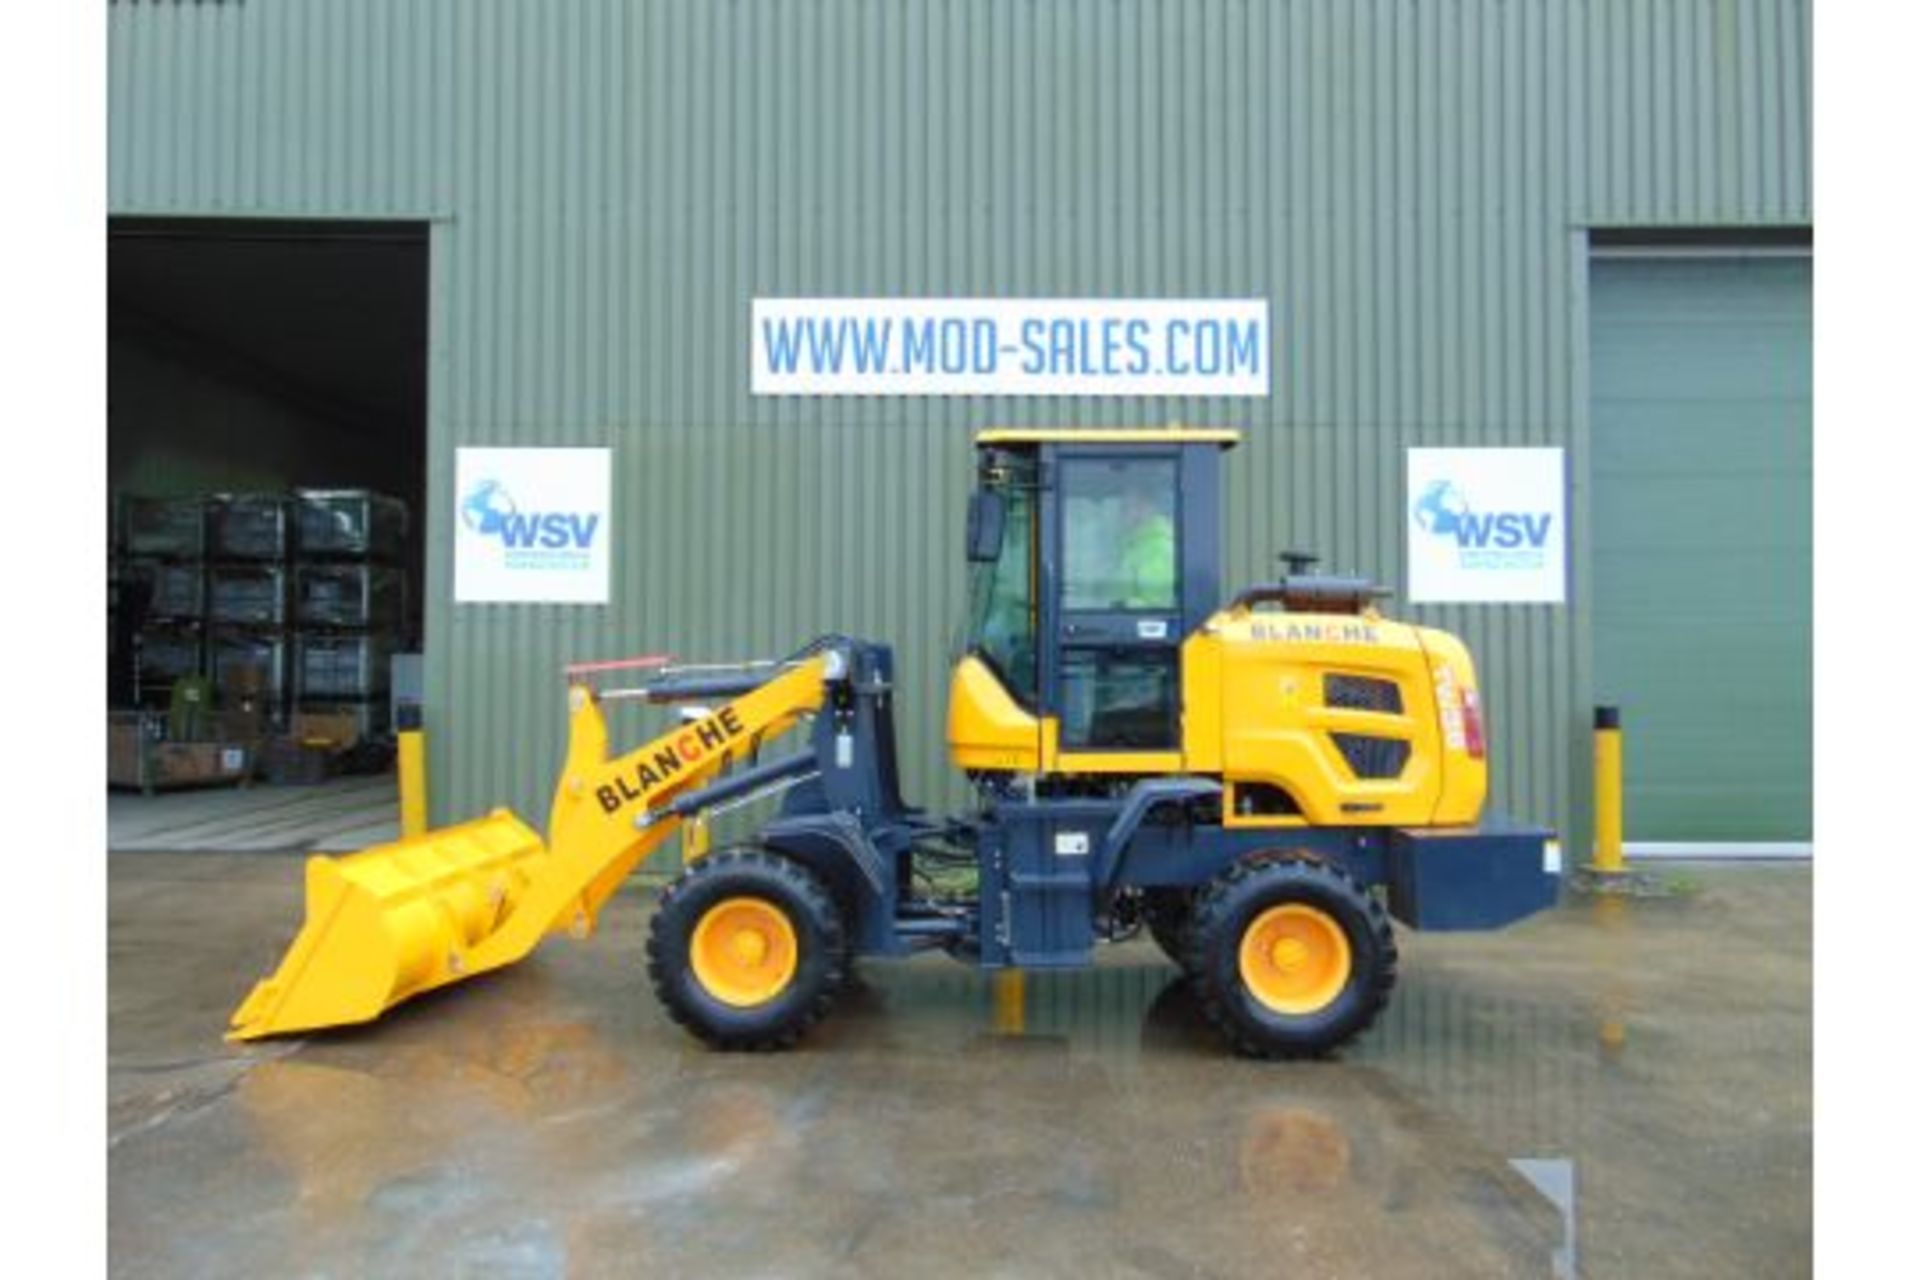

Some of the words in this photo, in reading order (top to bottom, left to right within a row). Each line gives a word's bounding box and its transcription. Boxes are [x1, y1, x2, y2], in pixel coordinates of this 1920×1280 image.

[763, 317, 1259, 375] WWW.MOD-SALES.COM
[499, 513, 598, 548] WSV
[1453, 513, 1551, 548] WSV
[1251, 623, 1379, 642] BLANCHE
[596, 706, 744, 813] BLANCHE
